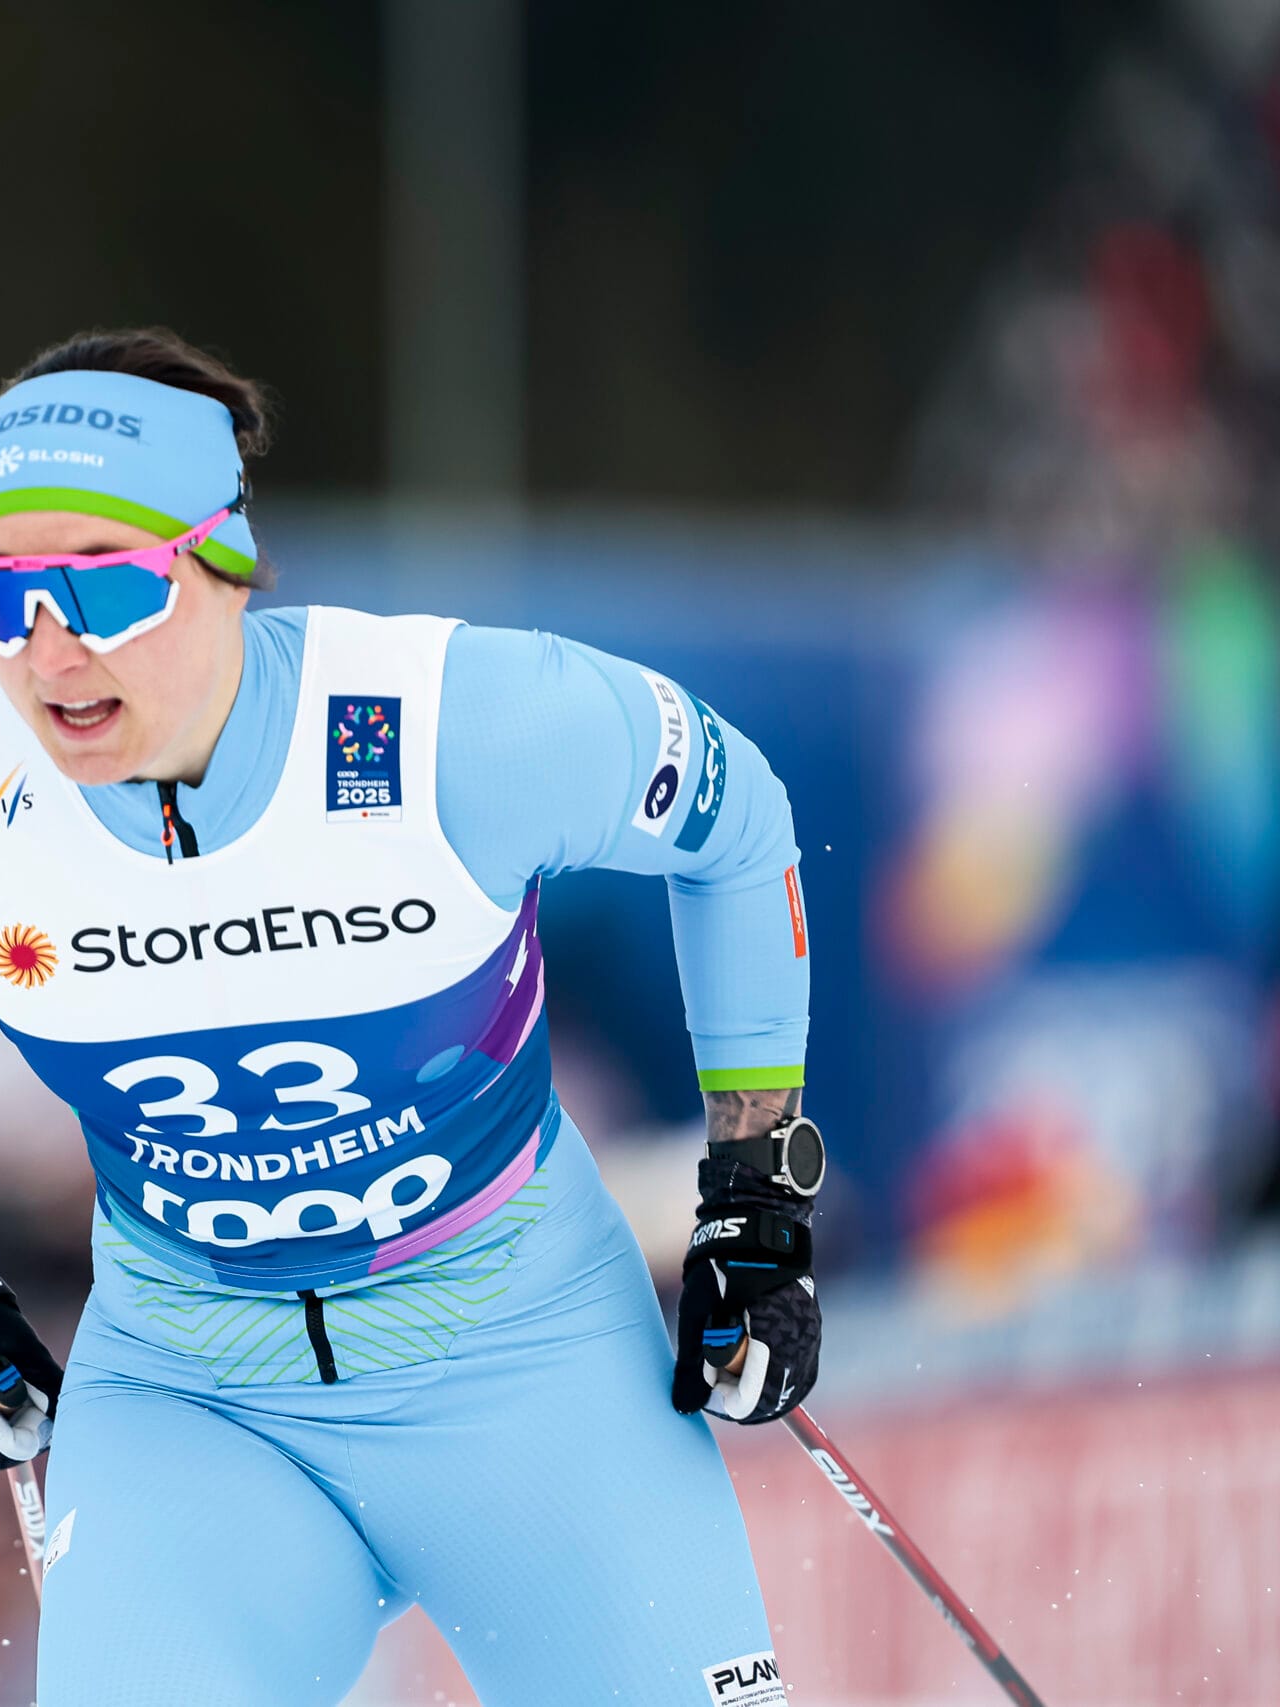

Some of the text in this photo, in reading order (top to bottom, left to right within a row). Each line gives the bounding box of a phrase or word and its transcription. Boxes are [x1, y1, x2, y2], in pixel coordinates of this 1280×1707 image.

[28, 449, 105, 468] SLOSKI
[656, 683, 683, 758] NLB
[337, 780, 390, 788] TRONDHEIM
[337, 788, 391, 805] 2025
[71, 898, 437, 973] StoraEnso
[103, 1041, 372, 1138] 33
[124, 1105, 426, 1182] TRONDHEIM
